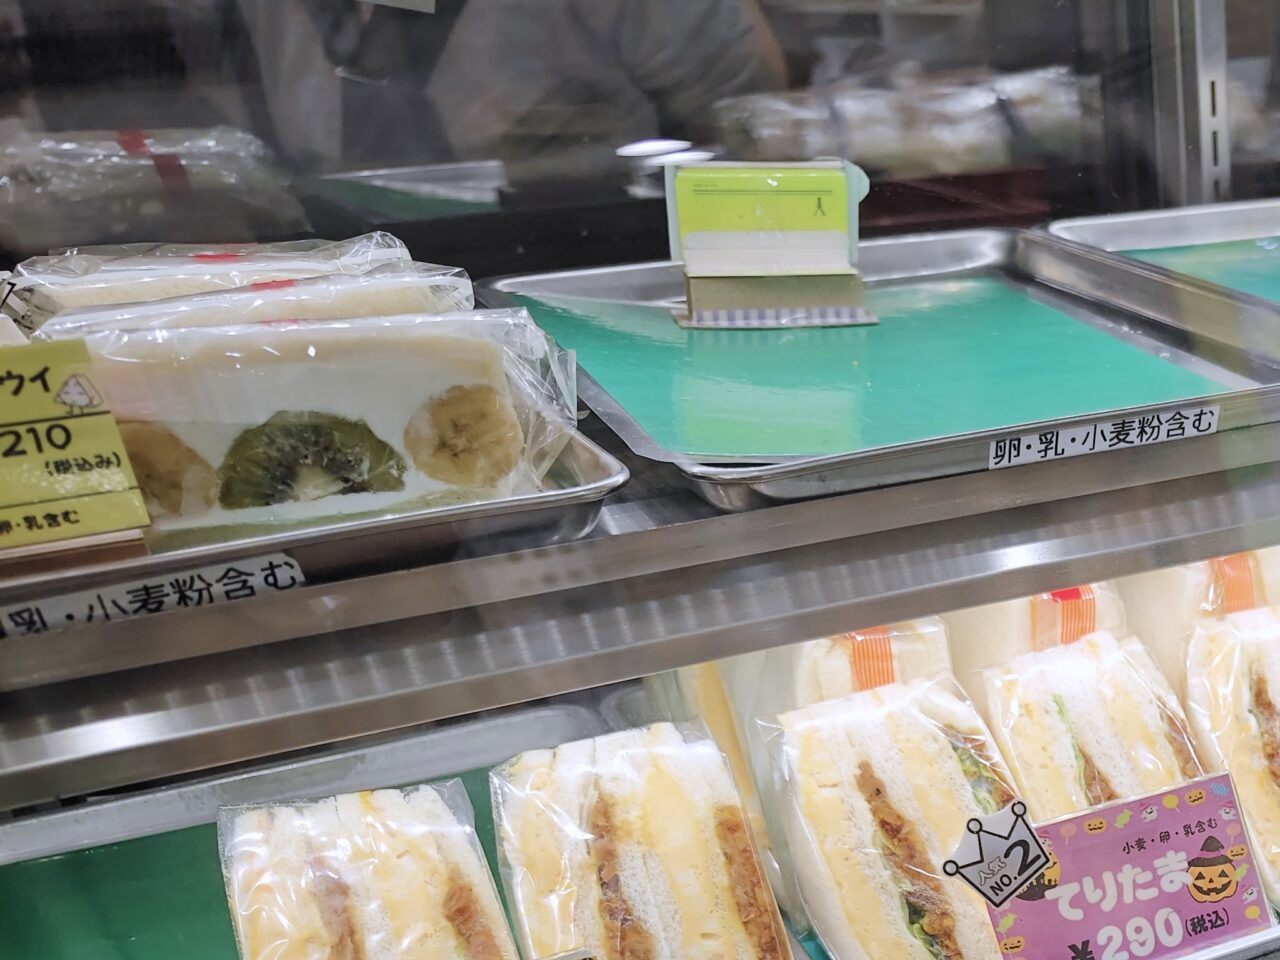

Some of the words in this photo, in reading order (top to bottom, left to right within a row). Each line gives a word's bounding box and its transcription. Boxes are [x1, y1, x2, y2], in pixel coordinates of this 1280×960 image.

[0, 423, 72, 458] 210
[992, 409, 1215, 465] 卵・乳・小麦粉含む
[0, 561, 297, 638] 乳・小麦粉含む
[1122, 817, 1218, 855] 小麦・卵・乳含む
[1045, 849, 1193, 922] てりたま
